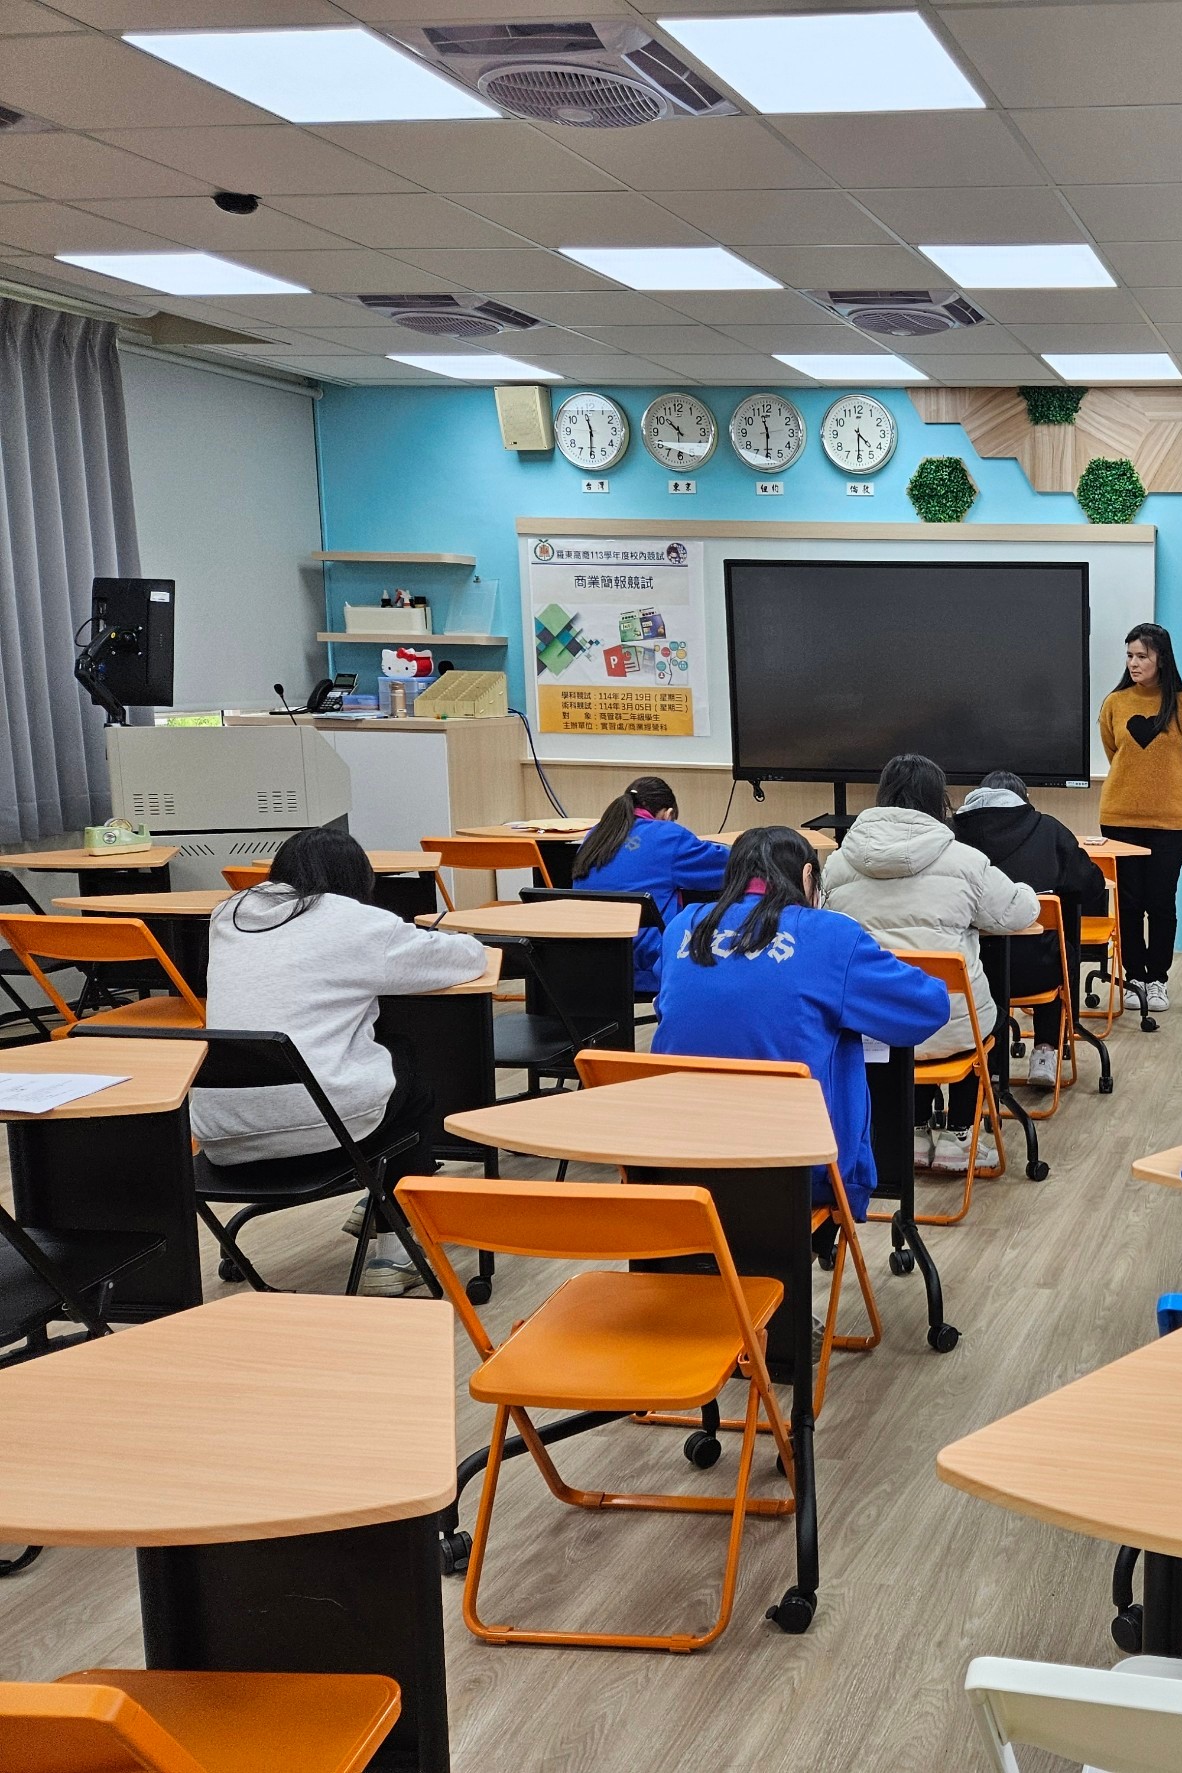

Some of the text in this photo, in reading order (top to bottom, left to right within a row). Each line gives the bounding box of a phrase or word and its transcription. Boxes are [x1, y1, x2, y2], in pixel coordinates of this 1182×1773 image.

[574, 575, 654, 590] 商業簡報競試
